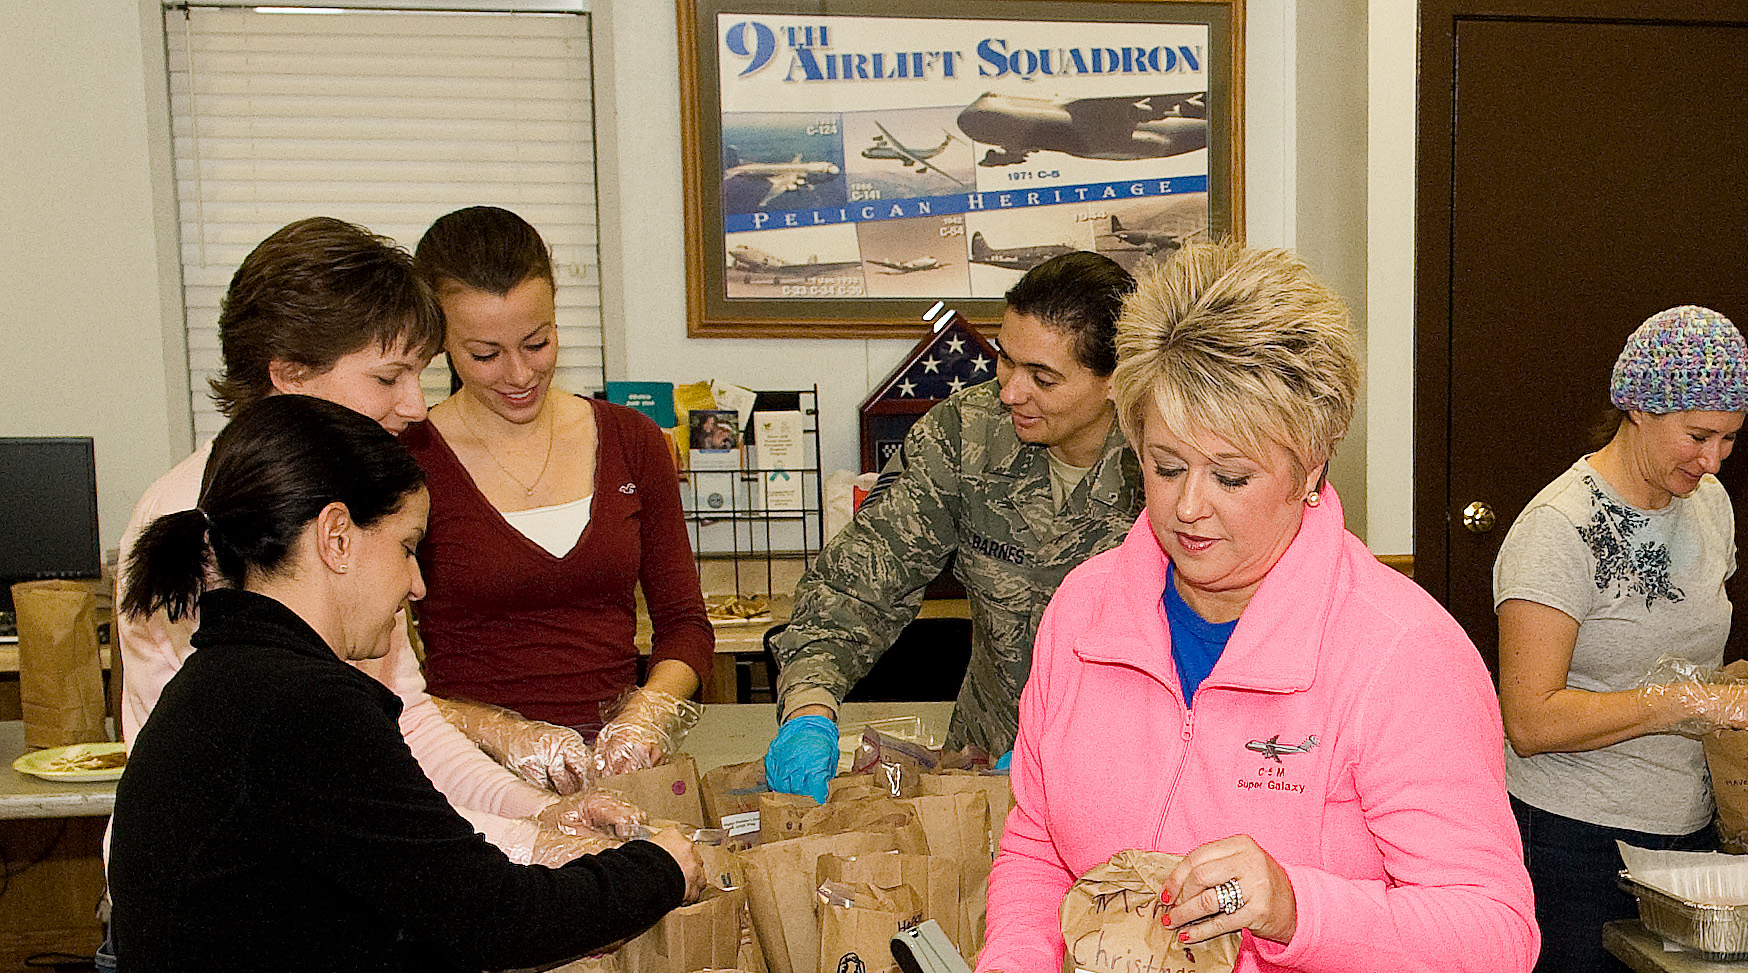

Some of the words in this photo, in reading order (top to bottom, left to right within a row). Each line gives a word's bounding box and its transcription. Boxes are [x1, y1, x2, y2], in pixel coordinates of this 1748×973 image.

[783, 44, 963, 81] AIRLIFT
[977, 38, 1201, 81] SQUADRON
[1008, 171, 1033, 181] 1971
[753, 201, 931, 230] PELICAN
[968, 181, 1172, 210] HERITAGE
[972, 533, 1025, 565] BARNES
[1237, 779, 1262, 791] Super
[1267, 780, 1305, 794] Galaxy
